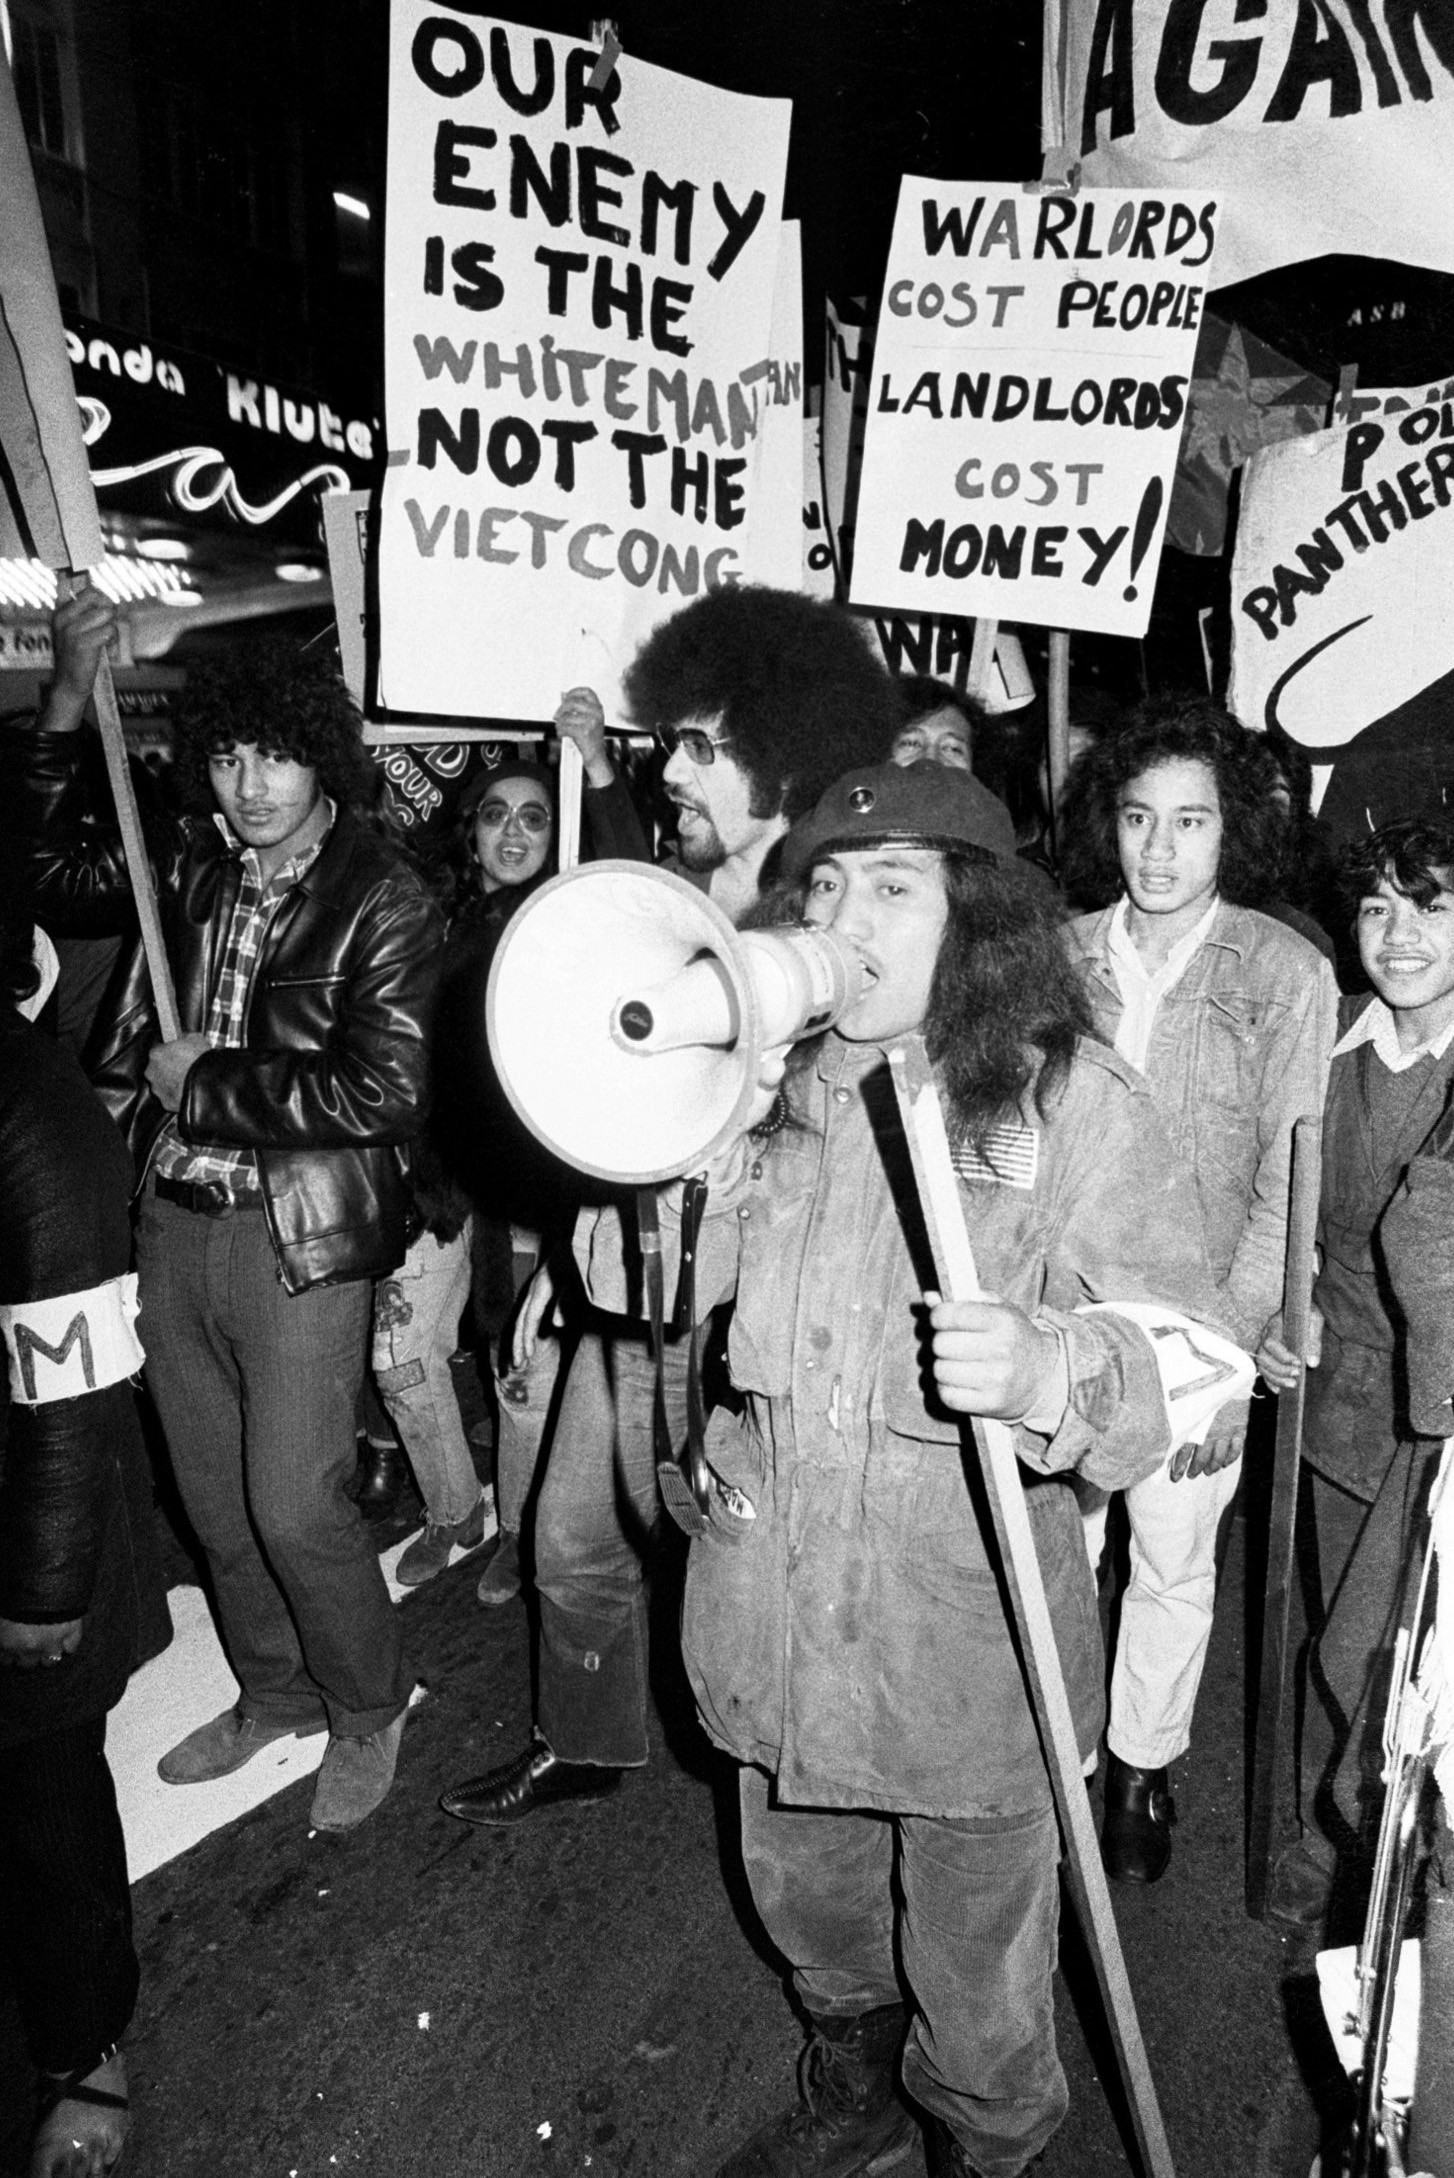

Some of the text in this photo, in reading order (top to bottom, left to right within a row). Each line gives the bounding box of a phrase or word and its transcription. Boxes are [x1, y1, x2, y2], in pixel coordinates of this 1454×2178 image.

[411, 16, 622, 138] OUR
[433, 118, 766, 283] ENEMY
[922, 196, 1217, 267] WARLORDS
[424, 235, 695, 358] IS THE
[888, 279, 1203, 331] COST PEOPLE
[64, 326, 186, 397] onda
[877, 371, 1189, 430] LANDLORDS
[418, 407, 599, 493] NOT
[611, 429, 748, 531] THE
[954, 457, 1104, 507] COST
[404, 498, 744, 597] VIETCONG
[899, 475, 1163, 603] MONEY!
[1241, 443, 1454, 641] PANTHER
[14, 1311, 97, 1401] M
